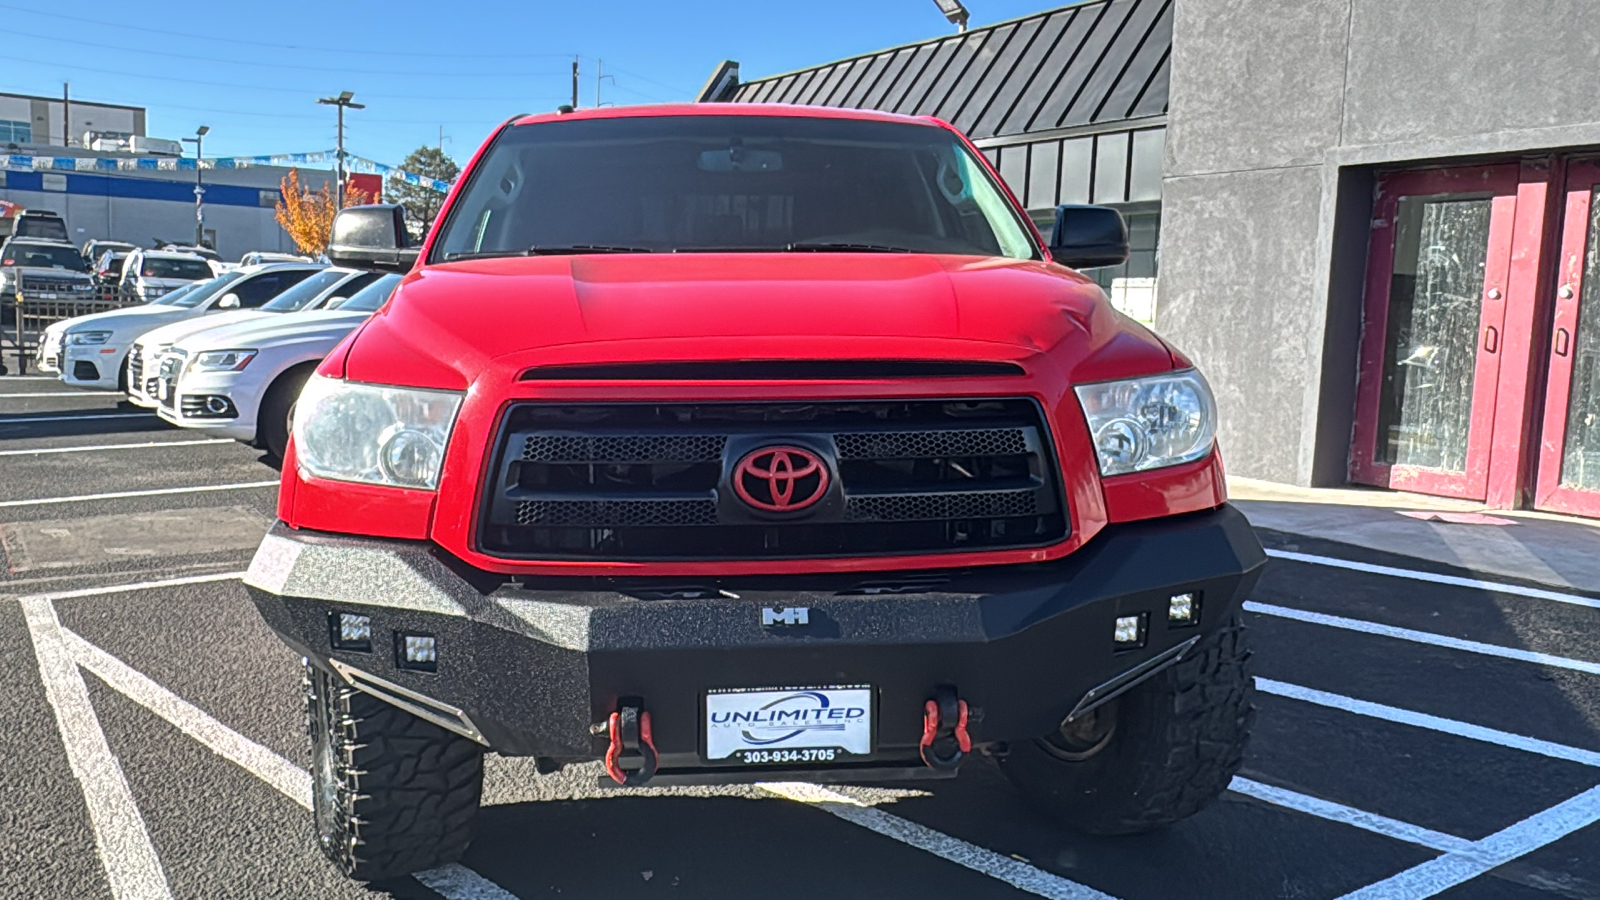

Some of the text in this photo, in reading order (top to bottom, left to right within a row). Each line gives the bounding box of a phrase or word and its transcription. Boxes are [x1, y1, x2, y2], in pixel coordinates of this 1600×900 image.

[711, 707, 865, 723] UNLIMITED
[768, 719, 822, 727] SALES
[743, 749, 835, 763] 303-934-3705
